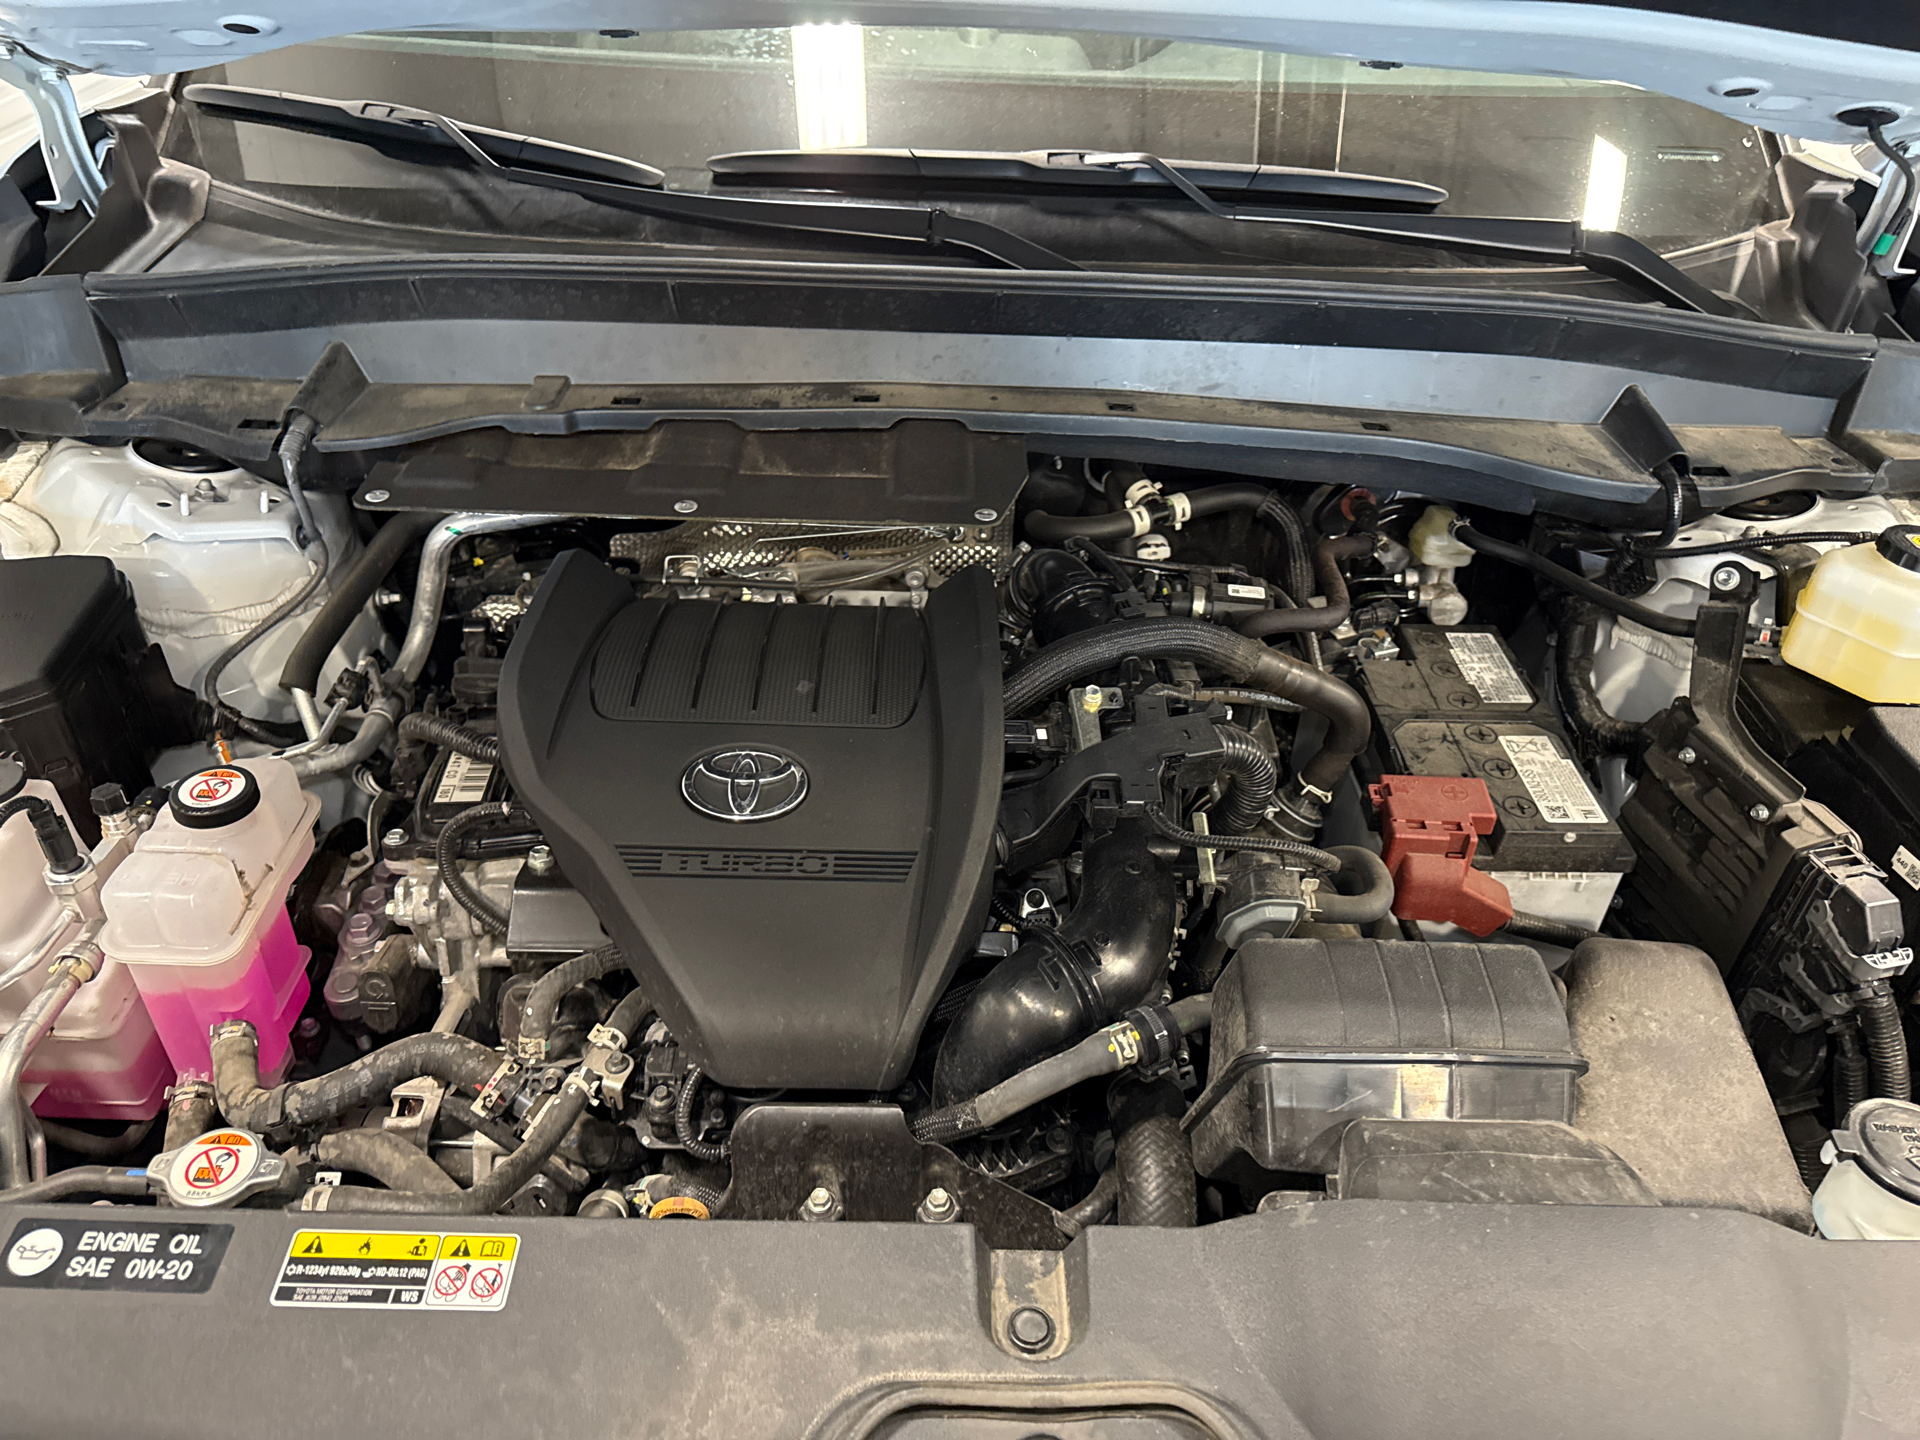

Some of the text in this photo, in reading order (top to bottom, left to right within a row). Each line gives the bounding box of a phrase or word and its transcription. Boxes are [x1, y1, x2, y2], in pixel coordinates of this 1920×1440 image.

[665, 852, 830, 874] TURBO
[1896, 857, 1908, 869] 440
[77, 1230, 203, 1255] ENGINE OIL
[65, 1256, 194, 1281] SAE 0W-20
[407, 1266, 428, 1280] (PAG)
[400, 1290, 420, 1303] WS
